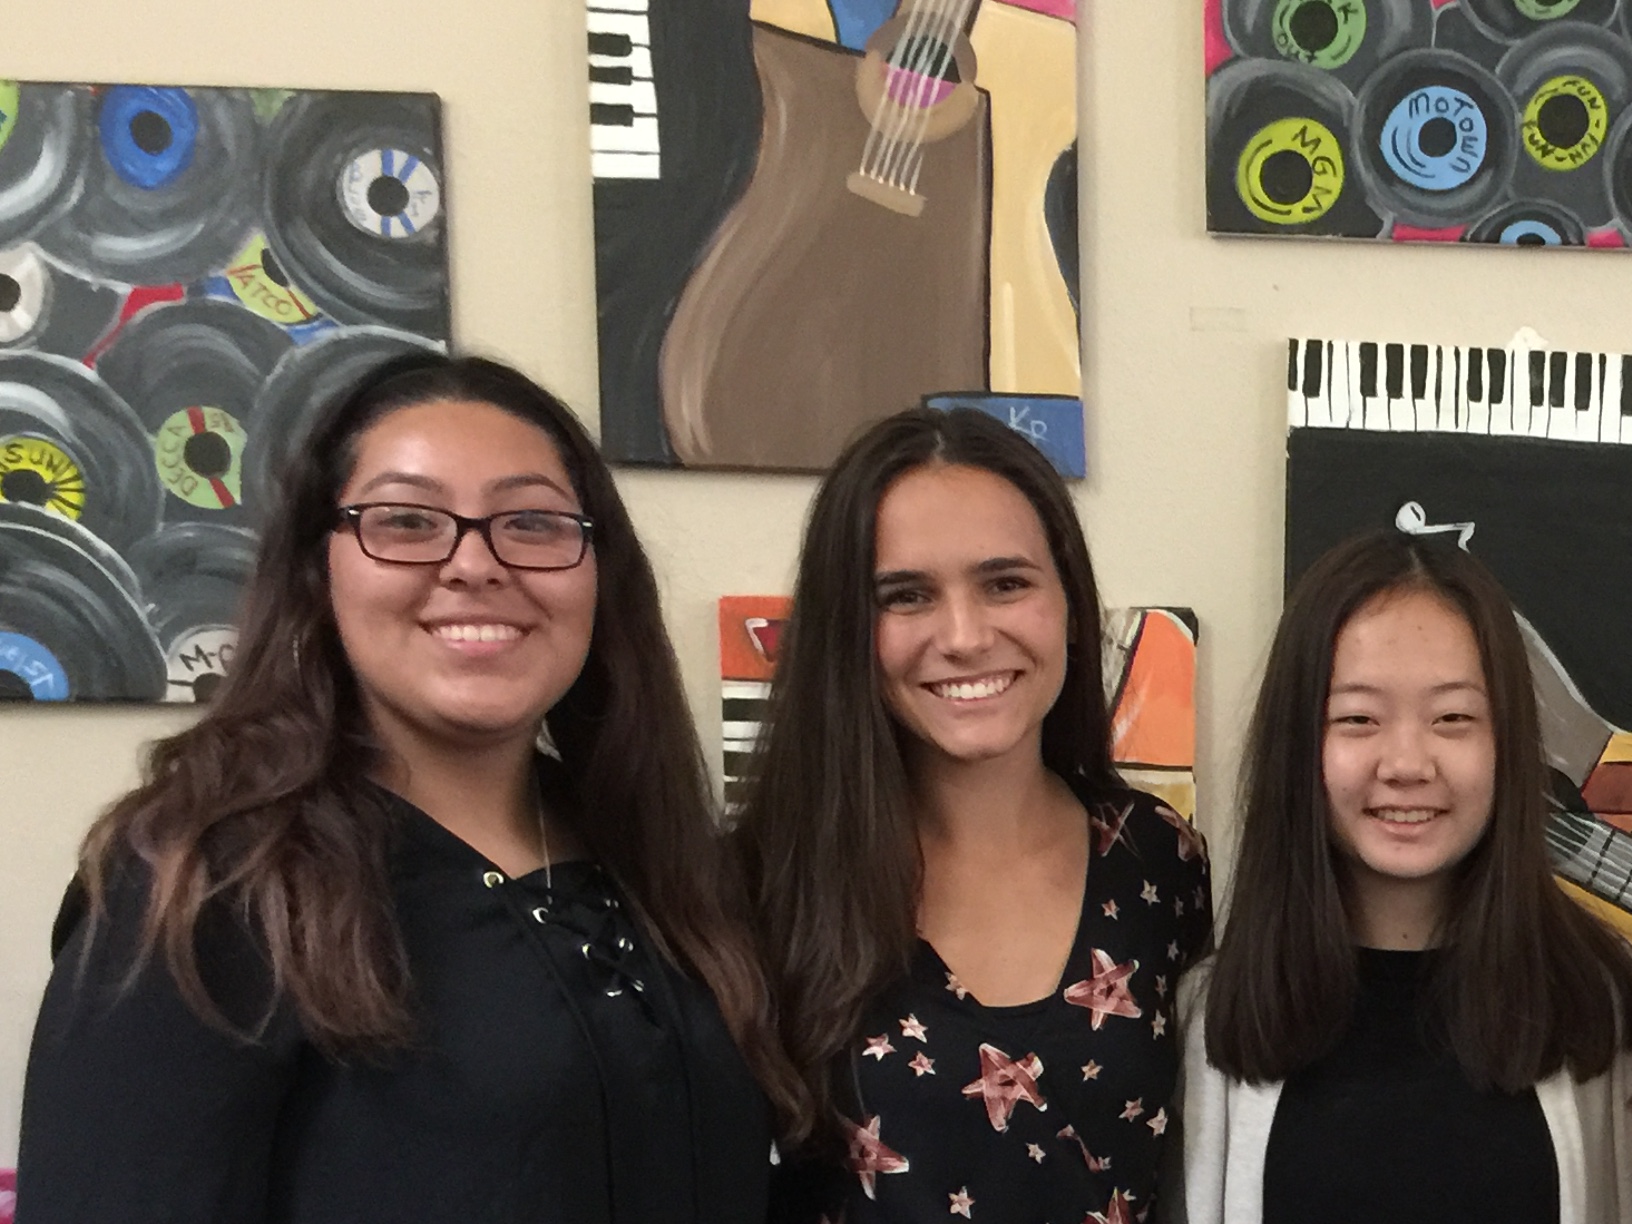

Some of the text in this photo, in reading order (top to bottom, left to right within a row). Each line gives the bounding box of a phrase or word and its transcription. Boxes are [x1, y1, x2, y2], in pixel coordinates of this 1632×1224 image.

[1291, 124, 1337, 214] MGM
[1408, 92, 1479, 174] MOTOWN
[4, 443, 67, 474] SUN
[161, 426, 199, 497] DECCA
